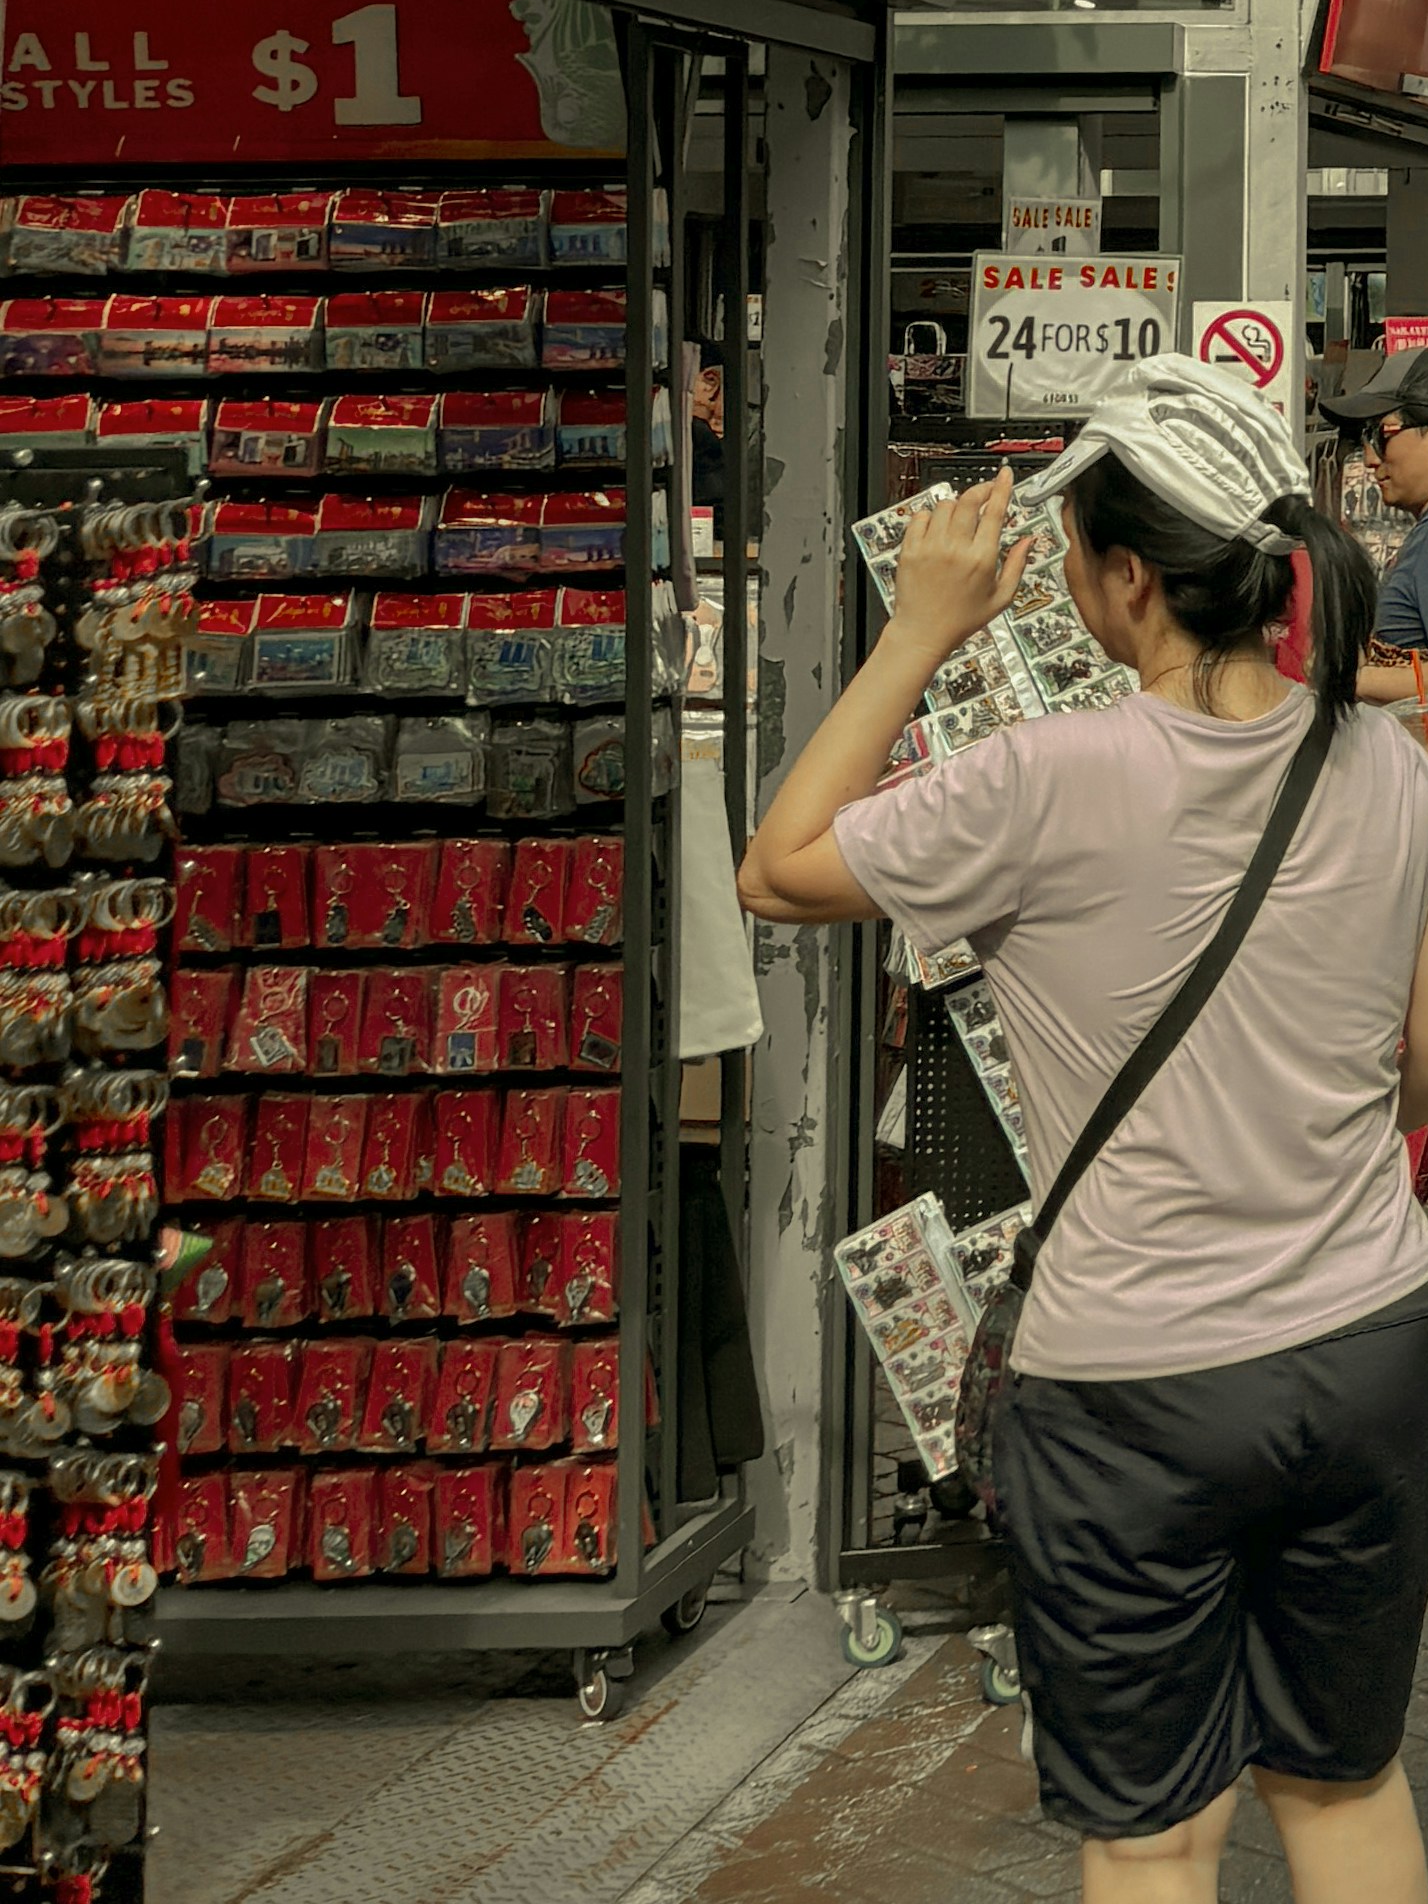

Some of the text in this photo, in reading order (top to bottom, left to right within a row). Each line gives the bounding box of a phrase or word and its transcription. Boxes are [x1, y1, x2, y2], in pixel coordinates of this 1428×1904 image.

[8, 31, 169, 72] ALL
[251, 3, 422, 126] $1
[2, 78, 195, 112] STYLES
[1012, 206, 1092, 229] SALE SALE
[983, 265, 1063, 290] SALE
[1080, 265, 1158, 290] SALE
[987, 315, 1037, 360] 24
[1041, 323, 1091, 352] FOR
